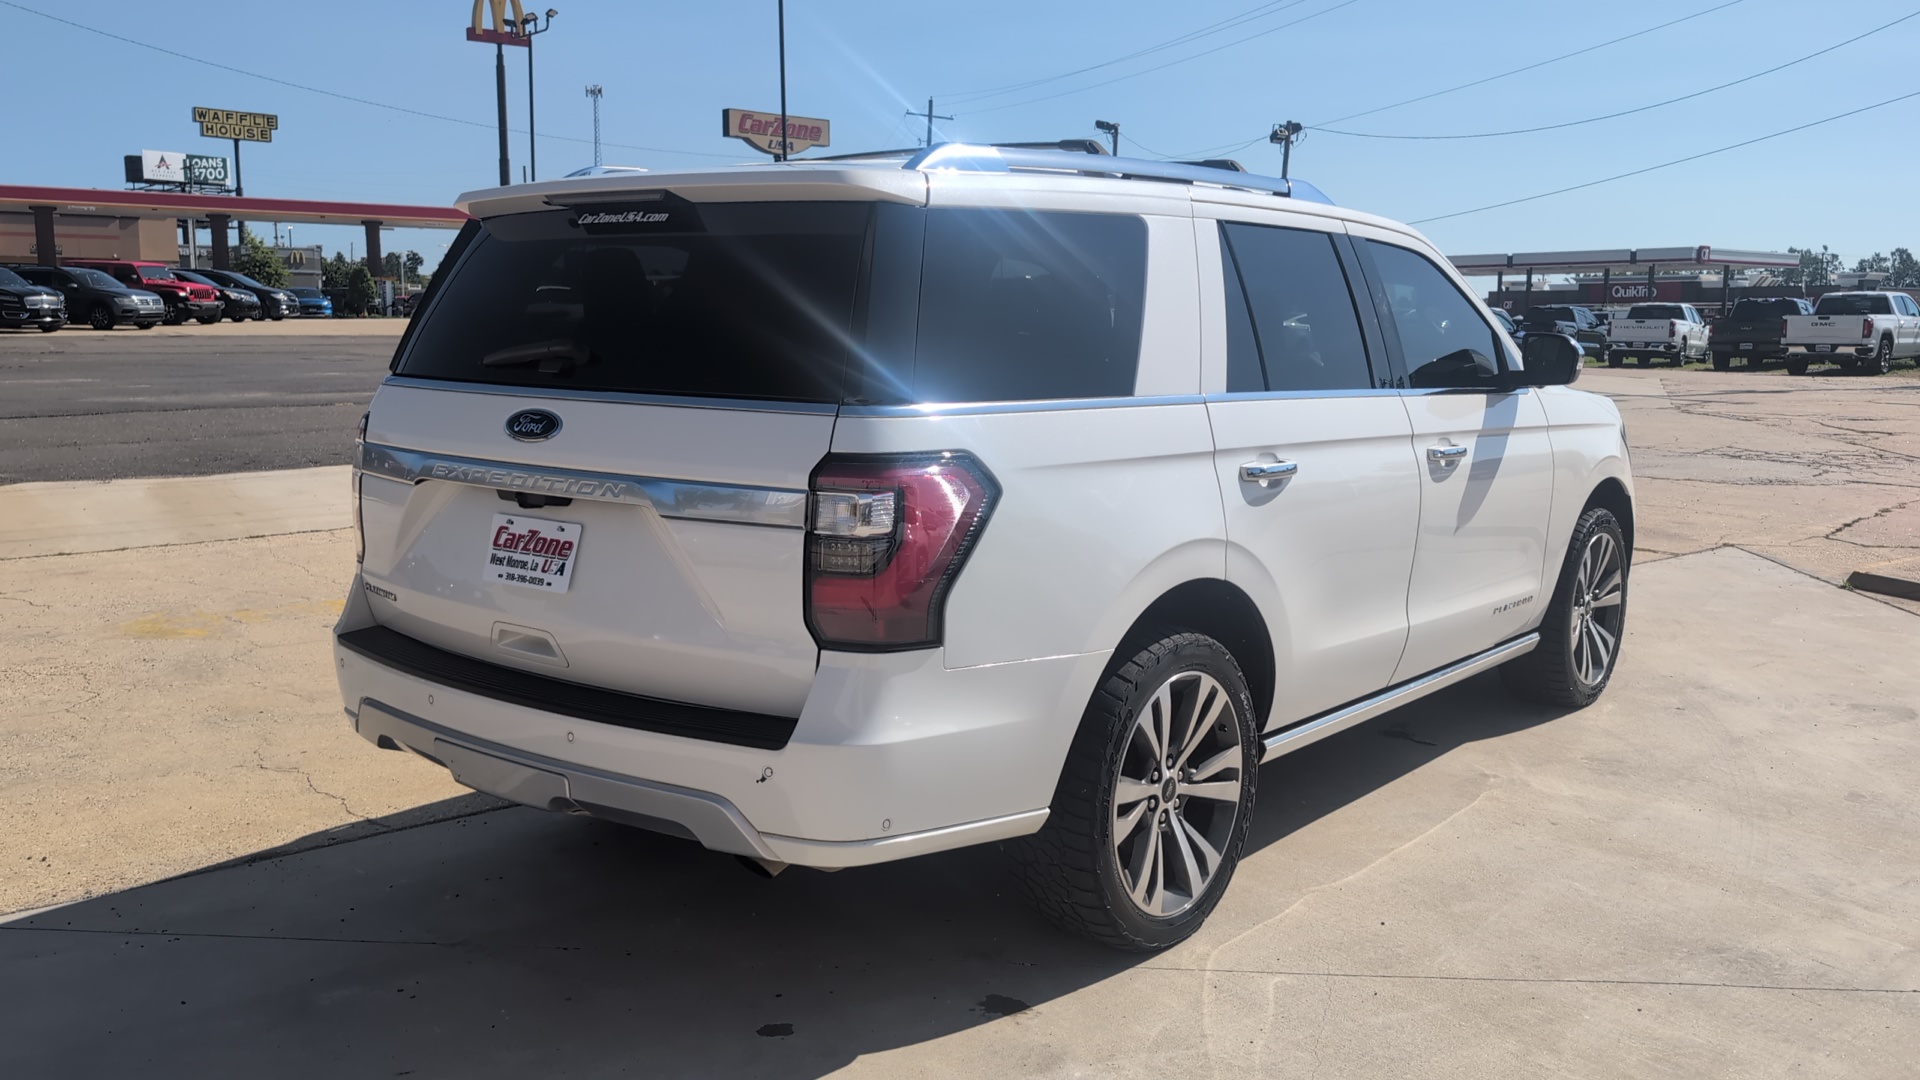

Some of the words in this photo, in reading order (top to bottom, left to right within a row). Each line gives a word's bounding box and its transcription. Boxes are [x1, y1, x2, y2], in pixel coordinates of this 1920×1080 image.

[197, 109, 275, 127] WAFFLE
[205, 124, 269, 139] HOUSE
[738, 112, 822, 141] CarZone
[767, 139, 794, 151] USA
[194, 168, 225, 180] $700
[578, 211, 669, 224] CarZoneUSA.com
[1503, 300, 1513, 309] QT
[513, 413, 548, 434] Ford
[431, 464, 626, 498] EXPEDITION
[492, 525, 574, 560] CarZone
[489, 552, 506, 566] West
[505, 554, 530, 572] Monroe,
[530, 559, 539, 572] La
[541, 559, 566, 576] USA
[504, 572, 545, 586] 318-396-0039
